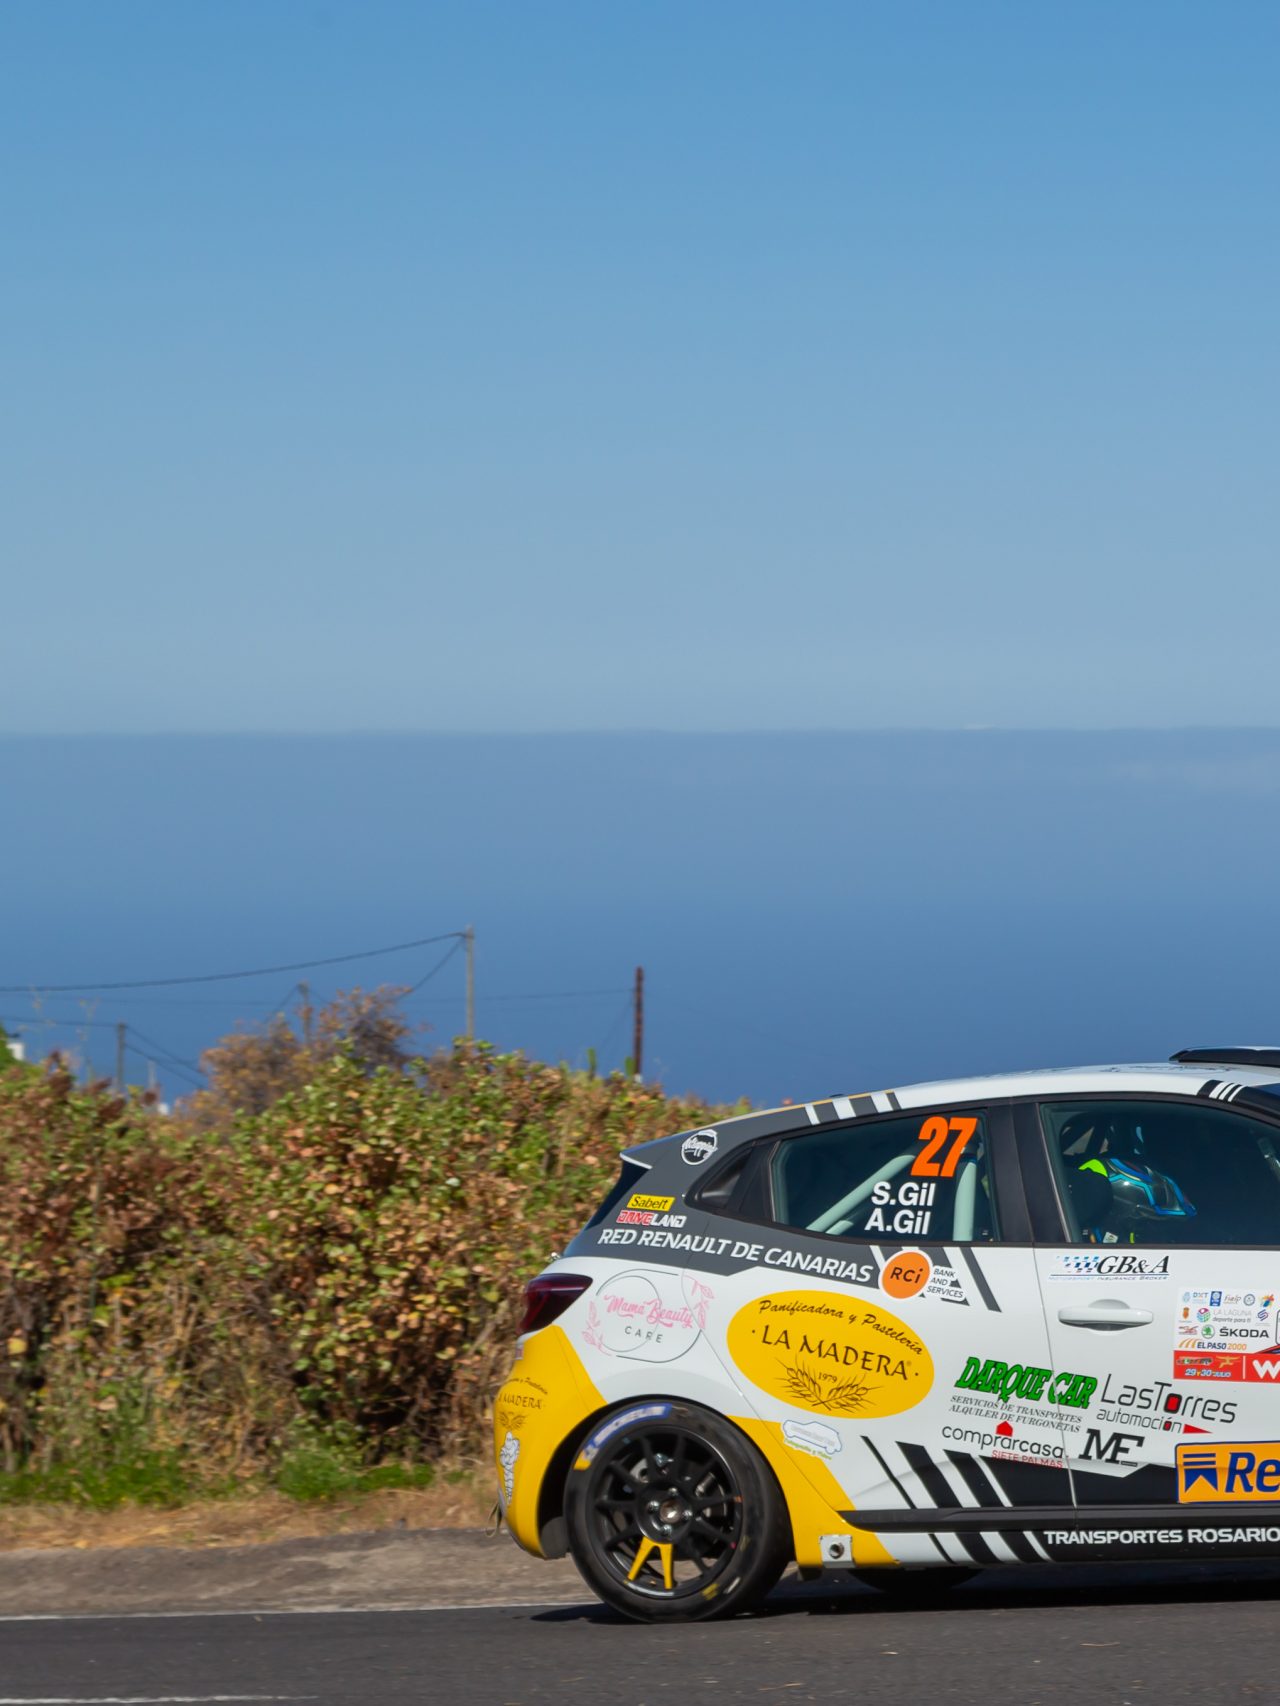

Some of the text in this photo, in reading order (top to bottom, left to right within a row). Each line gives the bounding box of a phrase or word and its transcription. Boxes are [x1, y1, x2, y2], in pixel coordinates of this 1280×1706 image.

[910, 1116, 978, 1177] 27
[631, 1196, 668, 1209] Sabelt
[871, 1180, 937, 1207] S.Gil
[616, 1210, 687, 1228] DRIVELAND
[864, 1207, 932, 1235] A.Gil
[598, 1229, 875, 1283] RED RENAULT DE CANARIAS
[1096, 1255, 1170, 1275] GB&A
[930, 1278, 949, 1286] AND
[933, 1267, 956, 1278] BANK
[927, 1285, 964, 1299] SERVICES
[604, 1295, 693, 1328] Mama Beauty
[625, 1326, 663, 1343] CARE
[759, 1300, 923, 1355] Panificadora y Pastelería
[1219, 1326, 1269, 1338] ŠKODA
[761, 1324, 909, 1381] LA MADERA
[1227, 1343, 1247, 1351] 2000
[818, 1372, 838, 1384] 1979
[954, 1356, 1098, 1409] DARQUE CAR
[949, 1404, 1081, 1433] ALQUILER DE FURGONETAS
[950, 1395, 1083, 1424] SERVICIOS DE TRANSPORTES
[1096, 1408, 1182, 1434] automoción
[942, 1425, 1065, 1459] comprarcasa
[991, 1450, 1063, 1469] SIETE PALMAS
[1044, 1530, 1183, 1545] TRANSPORTES
